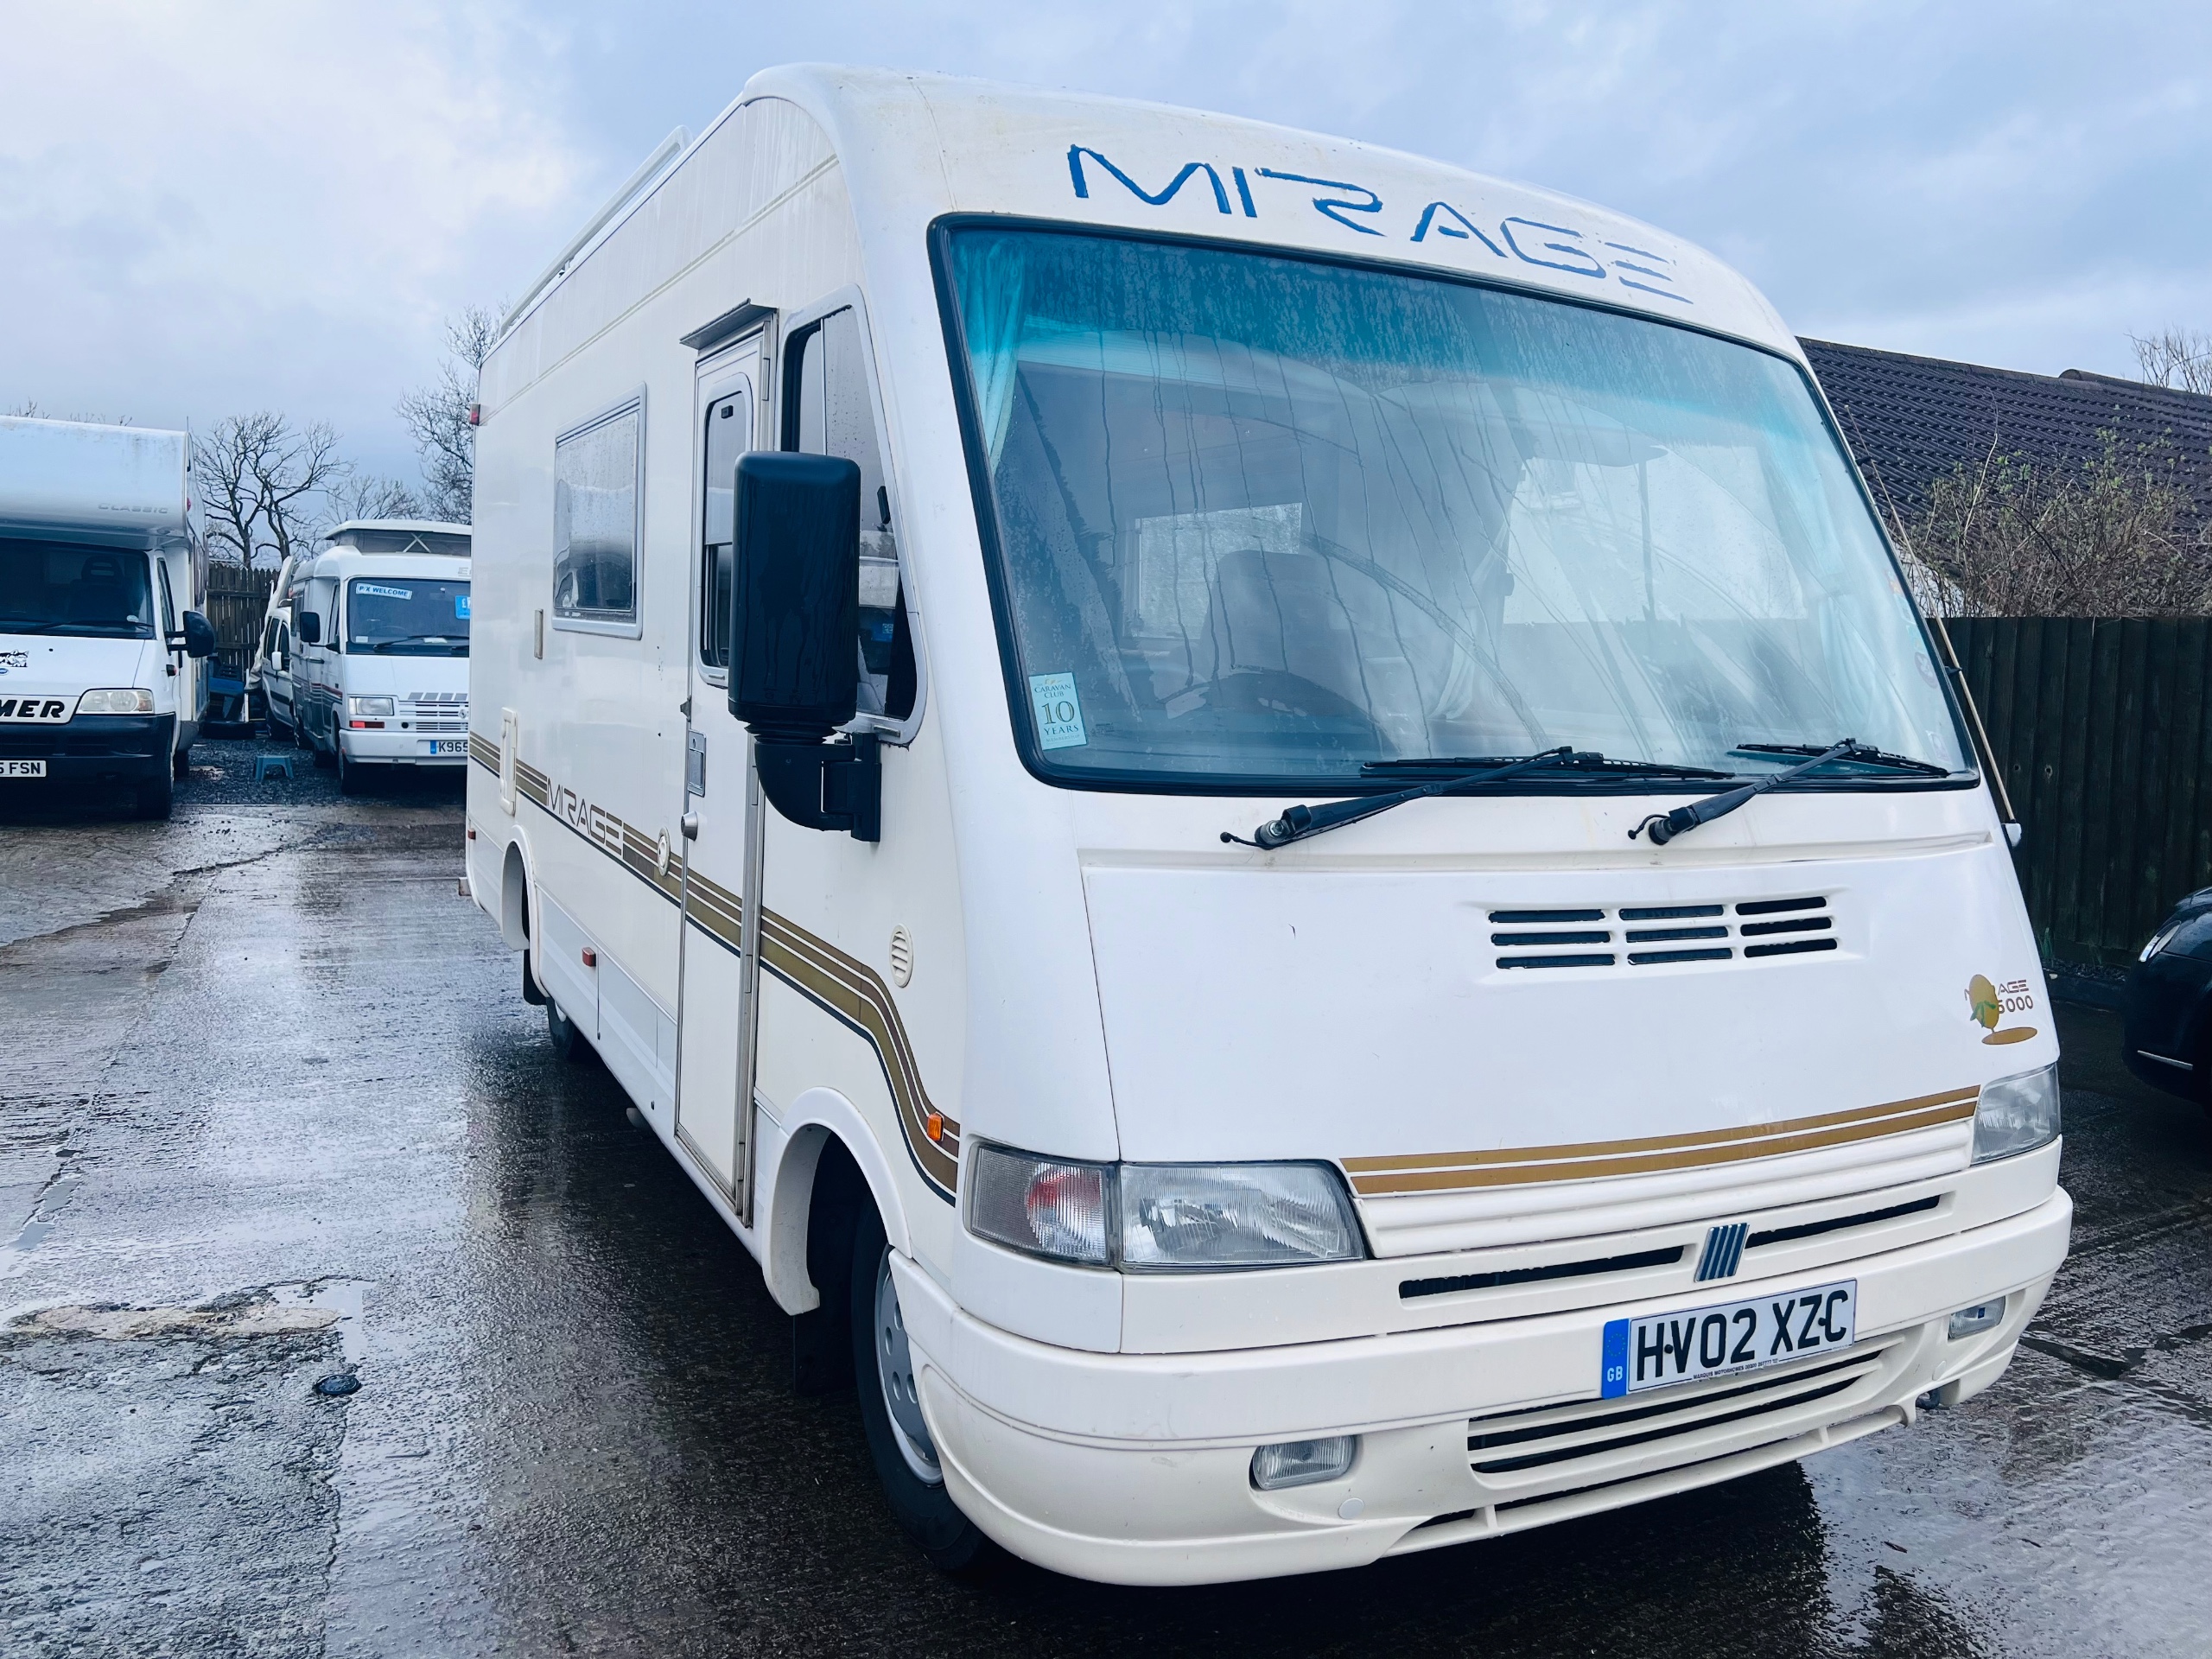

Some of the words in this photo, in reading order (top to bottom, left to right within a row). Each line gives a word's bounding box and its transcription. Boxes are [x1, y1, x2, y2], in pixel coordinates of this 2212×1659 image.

[1067, 144, 1694, 304] MIRAGE
[98, 503, 168, 513] CLASSIC
[372, 587, 409, 596] WELCOME
[1034, 683, 1071, 693] CARAVAN
[1041, 701, 1075, 725] 10
[1044, 725, 1079, 735] YEARS
[10, 762, 41, 774] FSN
[547, 777, 623, 856] MIRAGE
[1637, 1307, 1757, 1381] HV02
[1770, 1289, 1848, 1356] XZC
[1607, 1366, 1623, 1382] GB
